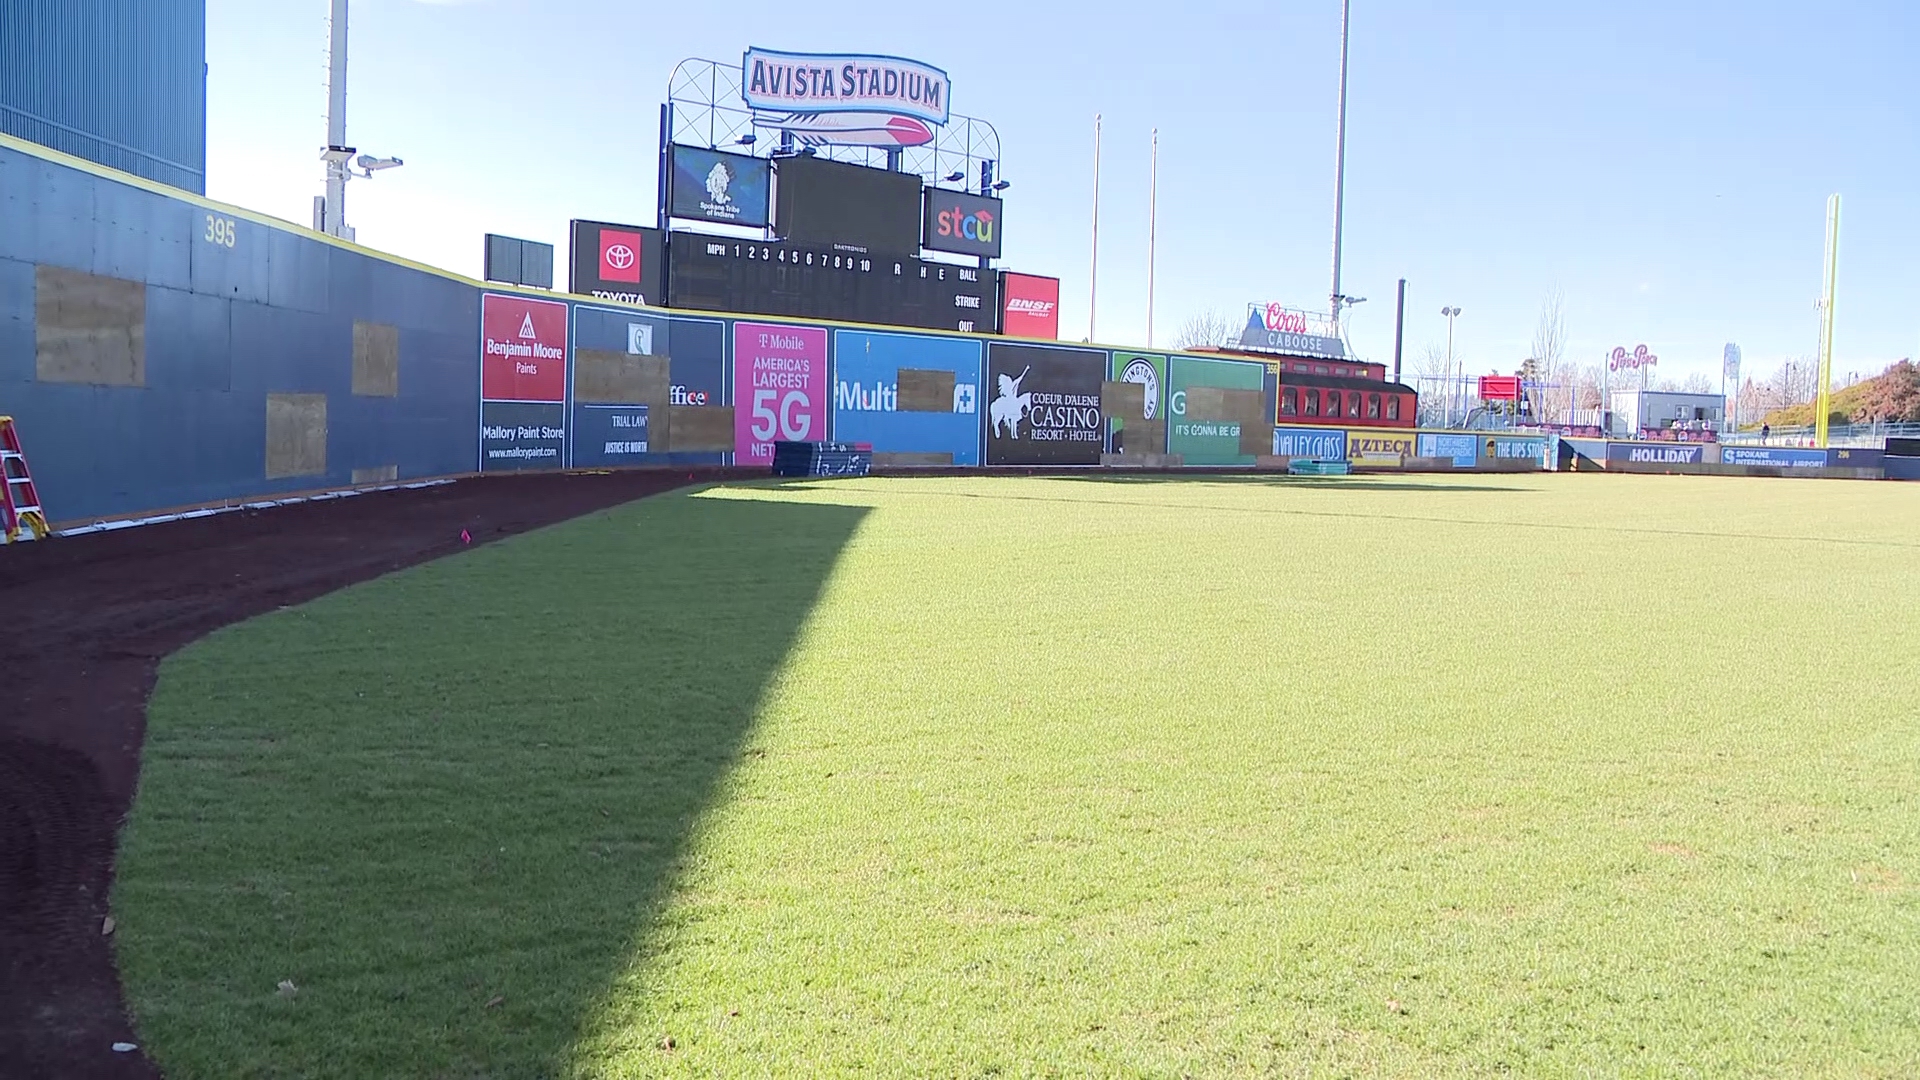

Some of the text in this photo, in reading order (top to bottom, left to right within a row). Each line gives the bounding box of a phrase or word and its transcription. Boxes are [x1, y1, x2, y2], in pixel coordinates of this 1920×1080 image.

[750, 58, 942, 109] AVISTA STADIUM
[700, 201, 740, 213] Spokane Tribe
[714, 210, 735, 219] Indians
[205, 214, 235, 248] 395
[937, 206, 993, 243] stcu
[707, 243, 871, 272] MPH 1 2 3 4 5 6 7 8 9 10
[894, 263, 977, 282] R H E BALL
[591, 290, 646, 306] TOYOTA
[955, 295, 980, 308] STRIKE
[1007, 298, 1055, 311] BNSF
[1266, 302, 1307, 333] Coors
[958, 320, 974, 332] OUT
[487, 338, 563, 359] Benjamin Moore
[770, 335, 804, 350] Mobile
[1268, 332, 1323, 351] CABOOSE
[516, 362, 537, 375] Paints
[753, 356, 810, 372] AMERICA'S
[753, 371, 810, 389] LARGEST
[670, 385, 705, 406] ffice
[839, 380, 898, 412] Multi
[1032, 392, 1099, 407] COEUR D'ALENE
[612, 415, 631, 427] TRIAL
[751, 389, 811, 442] 5G
[1031, 405, 1099, 429] CASINO
[483, 426, 563, 441] Mallory Paint Store
[1031, 429, 1098, 441] RESORT HOTEL
[1175, 424, 1241, 437] IT'S GONNA BE GR
[488, 446, 557, 459] www.mallorypaint.com
[604, 441, 624, 454] JUSTICE
[624, 441, 630, 453] IS
[751, 443, 776, 458] NET
[1280, 435, 1311, 456] VALLEY
[1312, 437, 1341, 460] GLASS
[1349, 438, 1412, 458] AZTECA
[1497, 442, 1546, 458] THE UPS STOR
[1630, 448, 1693, 463] HOLLIDAY
[1735, 450, 1770, 458] SPOKANE
